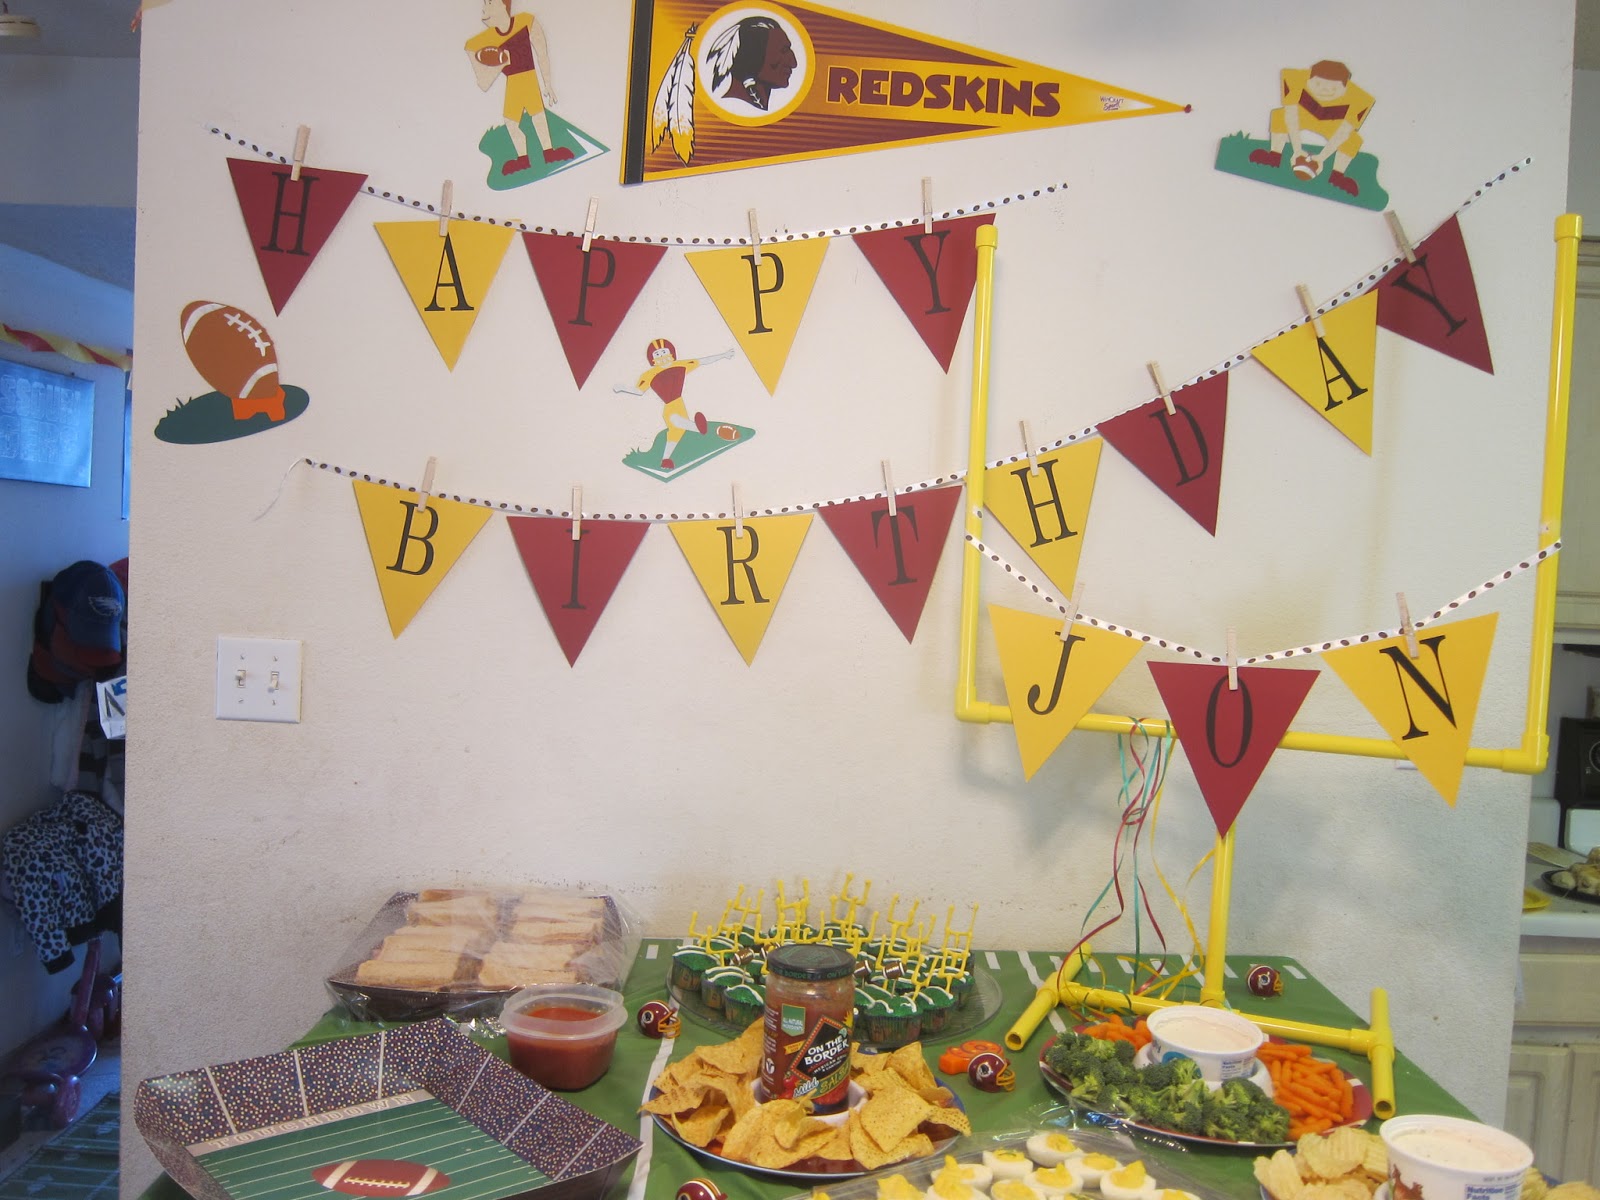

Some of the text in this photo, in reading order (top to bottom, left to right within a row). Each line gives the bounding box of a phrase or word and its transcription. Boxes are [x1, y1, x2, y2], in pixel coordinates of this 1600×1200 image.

[827, 67, 1060, 118] REDSKINS
[804, 1038, 849, 1065] BORDER
[807, 1044, 824, 1056] ON
[825, 1035, 843, 1049] THE
[208, 1093, 417, 1149] TOUCHDOWN
